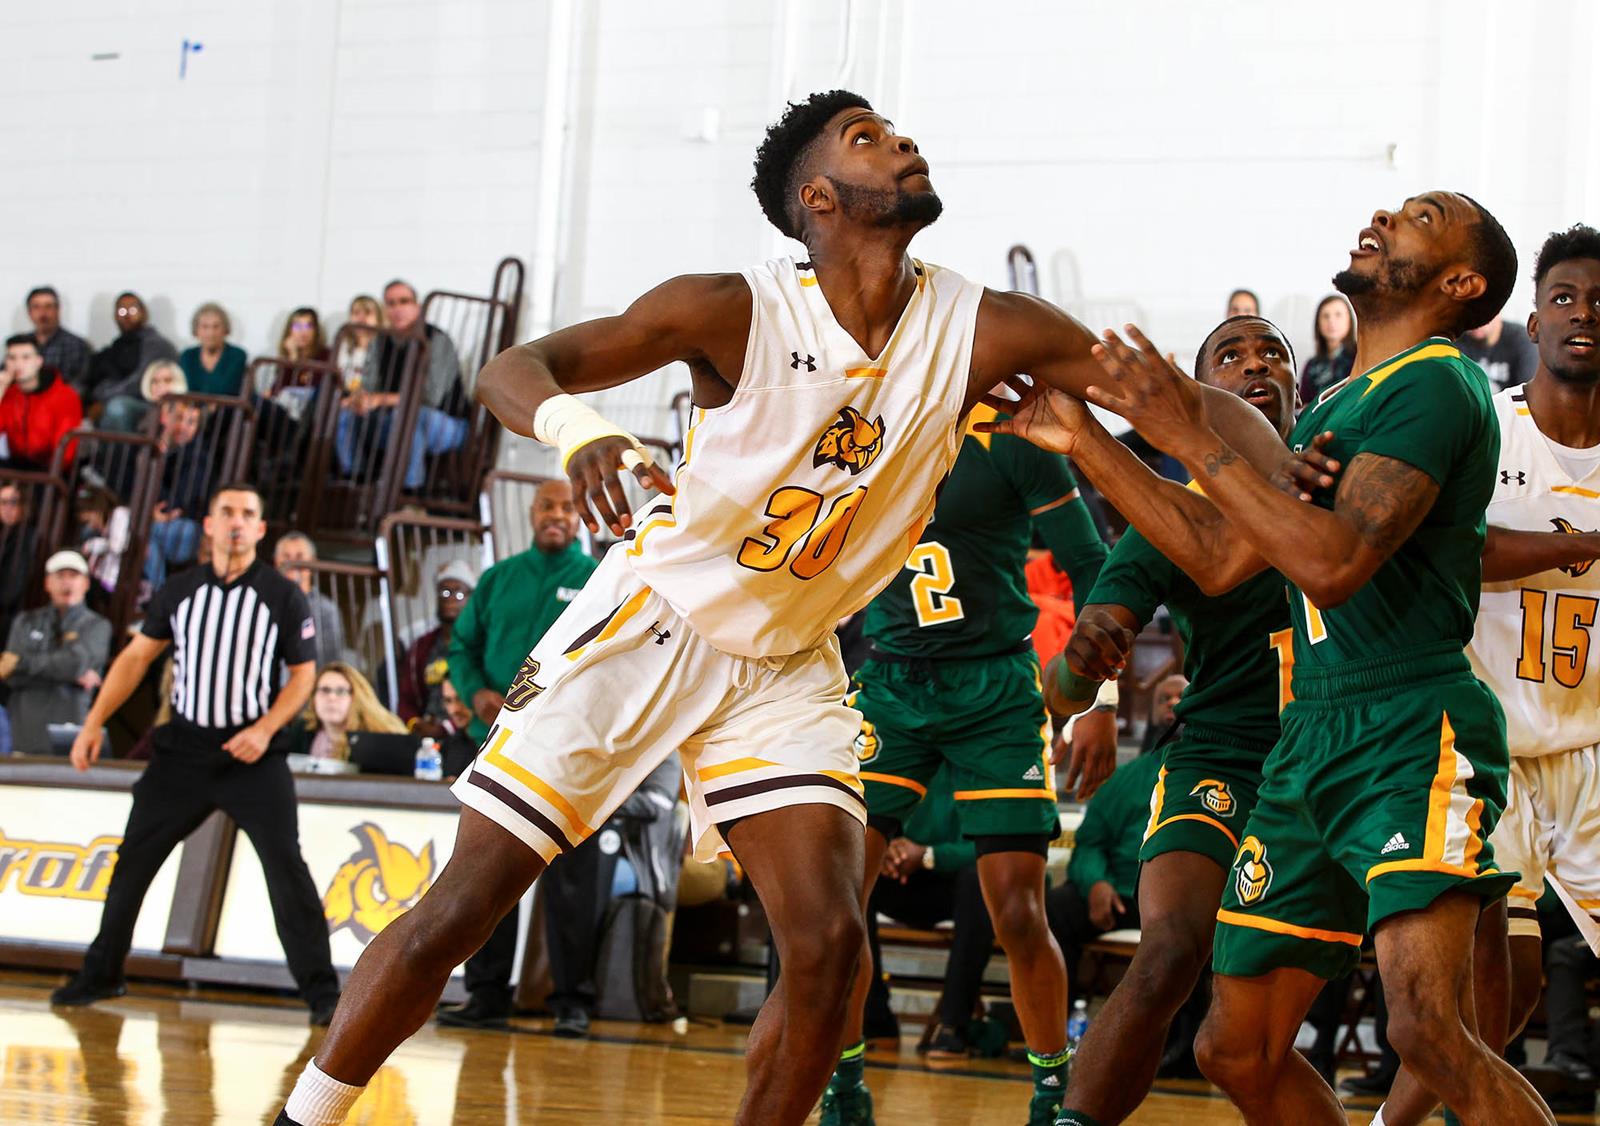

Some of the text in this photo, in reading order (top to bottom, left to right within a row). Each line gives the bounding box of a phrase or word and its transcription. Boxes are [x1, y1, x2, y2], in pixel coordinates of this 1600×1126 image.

[737, 486, 868, 580] 30
[905, 541, 964, 627] 2
[1516, 588, 1599, 688] 15
[0, 840, 120, 894] rof
